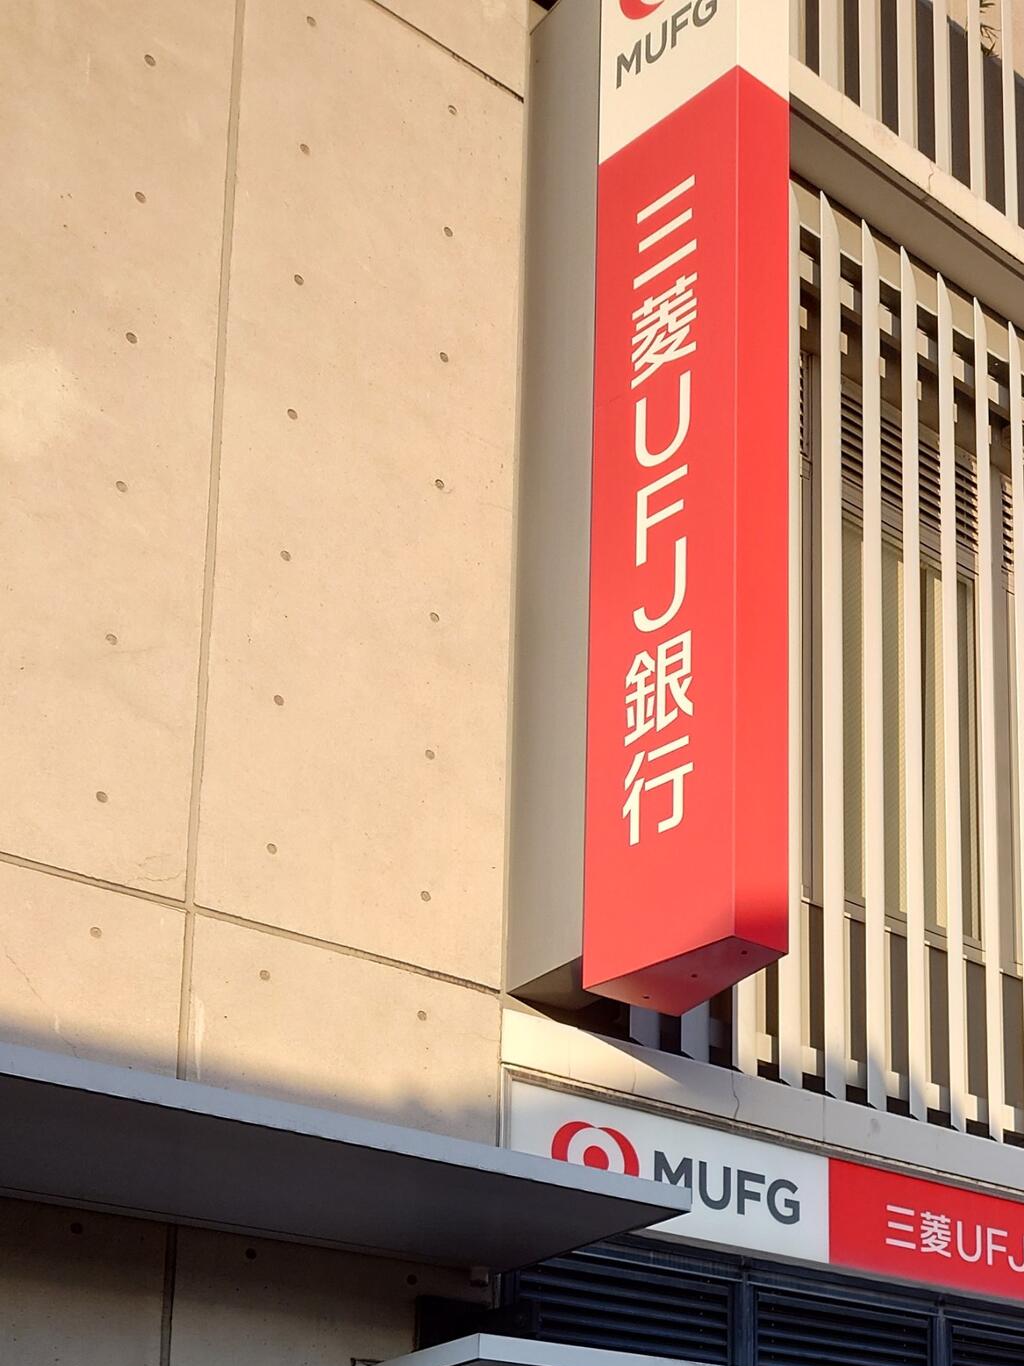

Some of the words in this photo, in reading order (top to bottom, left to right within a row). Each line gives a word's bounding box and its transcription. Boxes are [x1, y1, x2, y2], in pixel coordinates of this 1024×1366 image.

[615, 0, 718, 90] MUFG
[622, 174, 698, 848] 三菱UFJ銀行
[652, 1150, 801, 1225] MUFG
